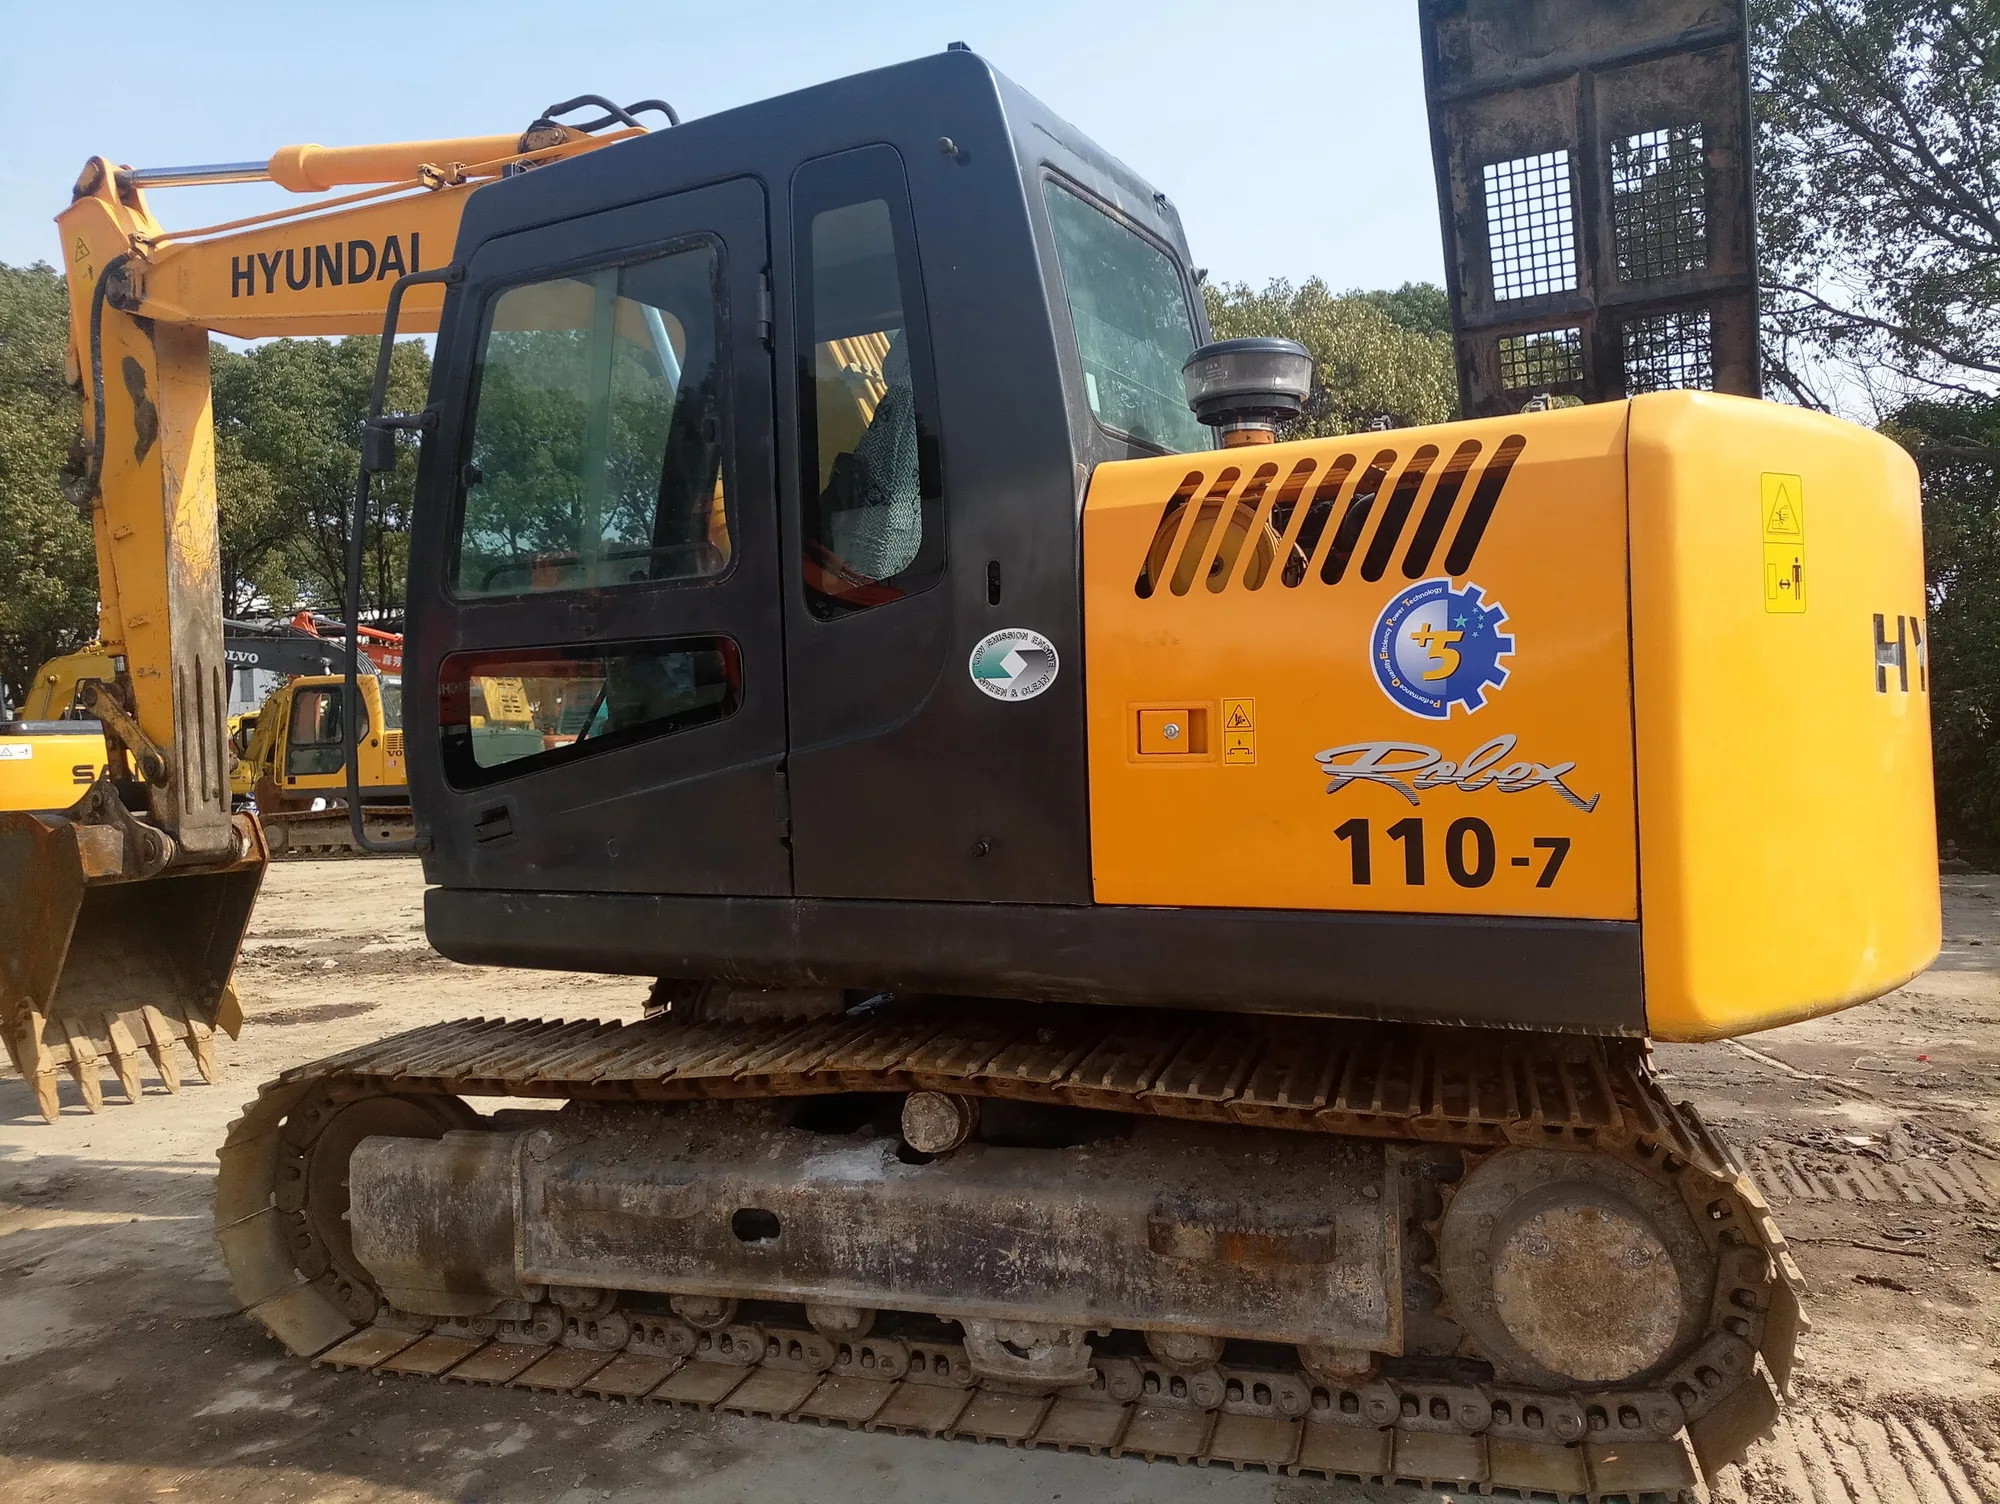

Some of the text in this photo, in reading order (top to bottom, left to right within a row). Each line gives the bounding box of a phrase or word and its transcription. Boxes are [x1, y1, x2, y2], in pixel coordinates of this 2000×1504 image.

[231, 232, 420, 298] HYUNDAI
[1385, 607, 1405, 626] Power
[1402, 587, 1443, 607] Technology
[224, 650, 259, 664] LVO
[973, 631, 1056, 668] LOW EMISSION ENGINE
[979, 674, 1050, 698] GREEN & CLEAN
[1314, 734, 1600, 813] Robex
